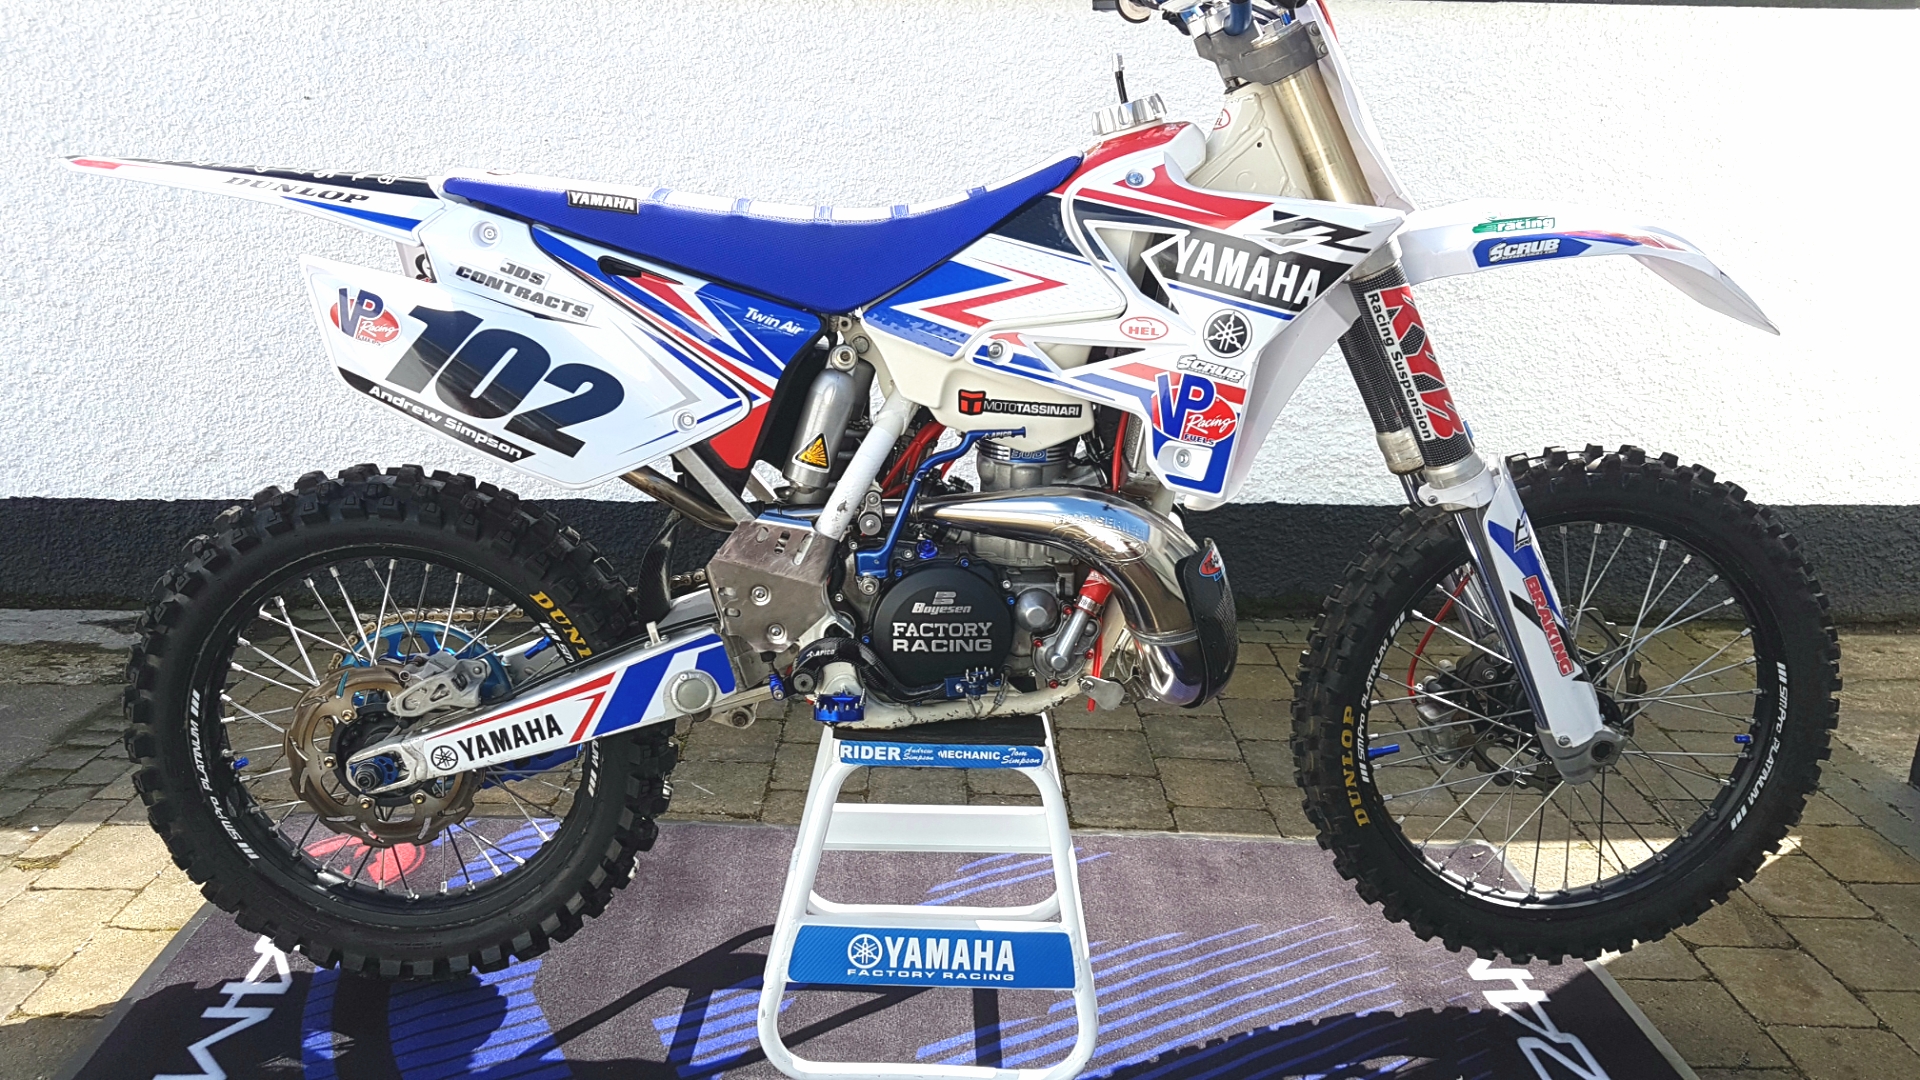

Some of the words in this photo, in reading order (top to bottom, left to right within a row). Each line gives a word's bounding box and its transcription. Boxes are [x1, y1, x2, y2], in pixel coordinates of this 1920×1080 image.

[223, 177, 370, 203] DUNLOP
[571, 193, 635, 211] YAMAHA
[1489, 238, 1560, 263] SCRUB
[501, 262, 545, 285] JDS
[1174, 238, 1322, 305] YAMAHA
[456, 266, 588, 317] CONTRACTS
[338, 288, 384, 337] VP
[745, 306, 780, 328] Twin
[1368, 292, 1395, 347] Racing
[360, 321, 399, 338] Racing
[779, 320, 804, 335] Air
[1128, 326, 1160, 337] HEL
[1177, 355, 1245, 381] SCRUB
[1380, 287, 1464, 438] KYB
[384, 305, 625, 458] 102
[368, 387, 444, 424] Andrew
[1157, 374, 1214, 438] VP
[1391, 352, 1431, 440] Suspension
[983, 401, 1080, 417] MOTOTASSINARI
[1186, 414, 1236, 434] Racing
[443, 418, 524, 459] Simpson
[1184, 434, 1215, 446] FUELS
[911, 602, 972, 615] Boyesen
[892, 622, 993, 637] FACTORY
[1525, 577, 1574, 675] BRAKING
[892, 638, 993, 653] RACING
[1361, 639, 1389, 709] PLATINUM
[457, 714, 563, 761] YAMAHA
[190, 719, 213, 792] PLATINUM
[840, 745, 900, 760] RIDER
[902, 753, 934, 761] Simpson
[938, 750, 1000, 760] MECHANIC
[1001, 755, 1040, 765] Simpson
[1010, 748, 1028, 757] Tom
[1341, 706, 1370, 827] DUNLOP
[1748, 736, 1781, 805] PLATINUM
[884, 936, 1015, 972] YAMAHA
[847, 969, 935, 979] FACTORY
[943, 971, 1014, 981] RACING
